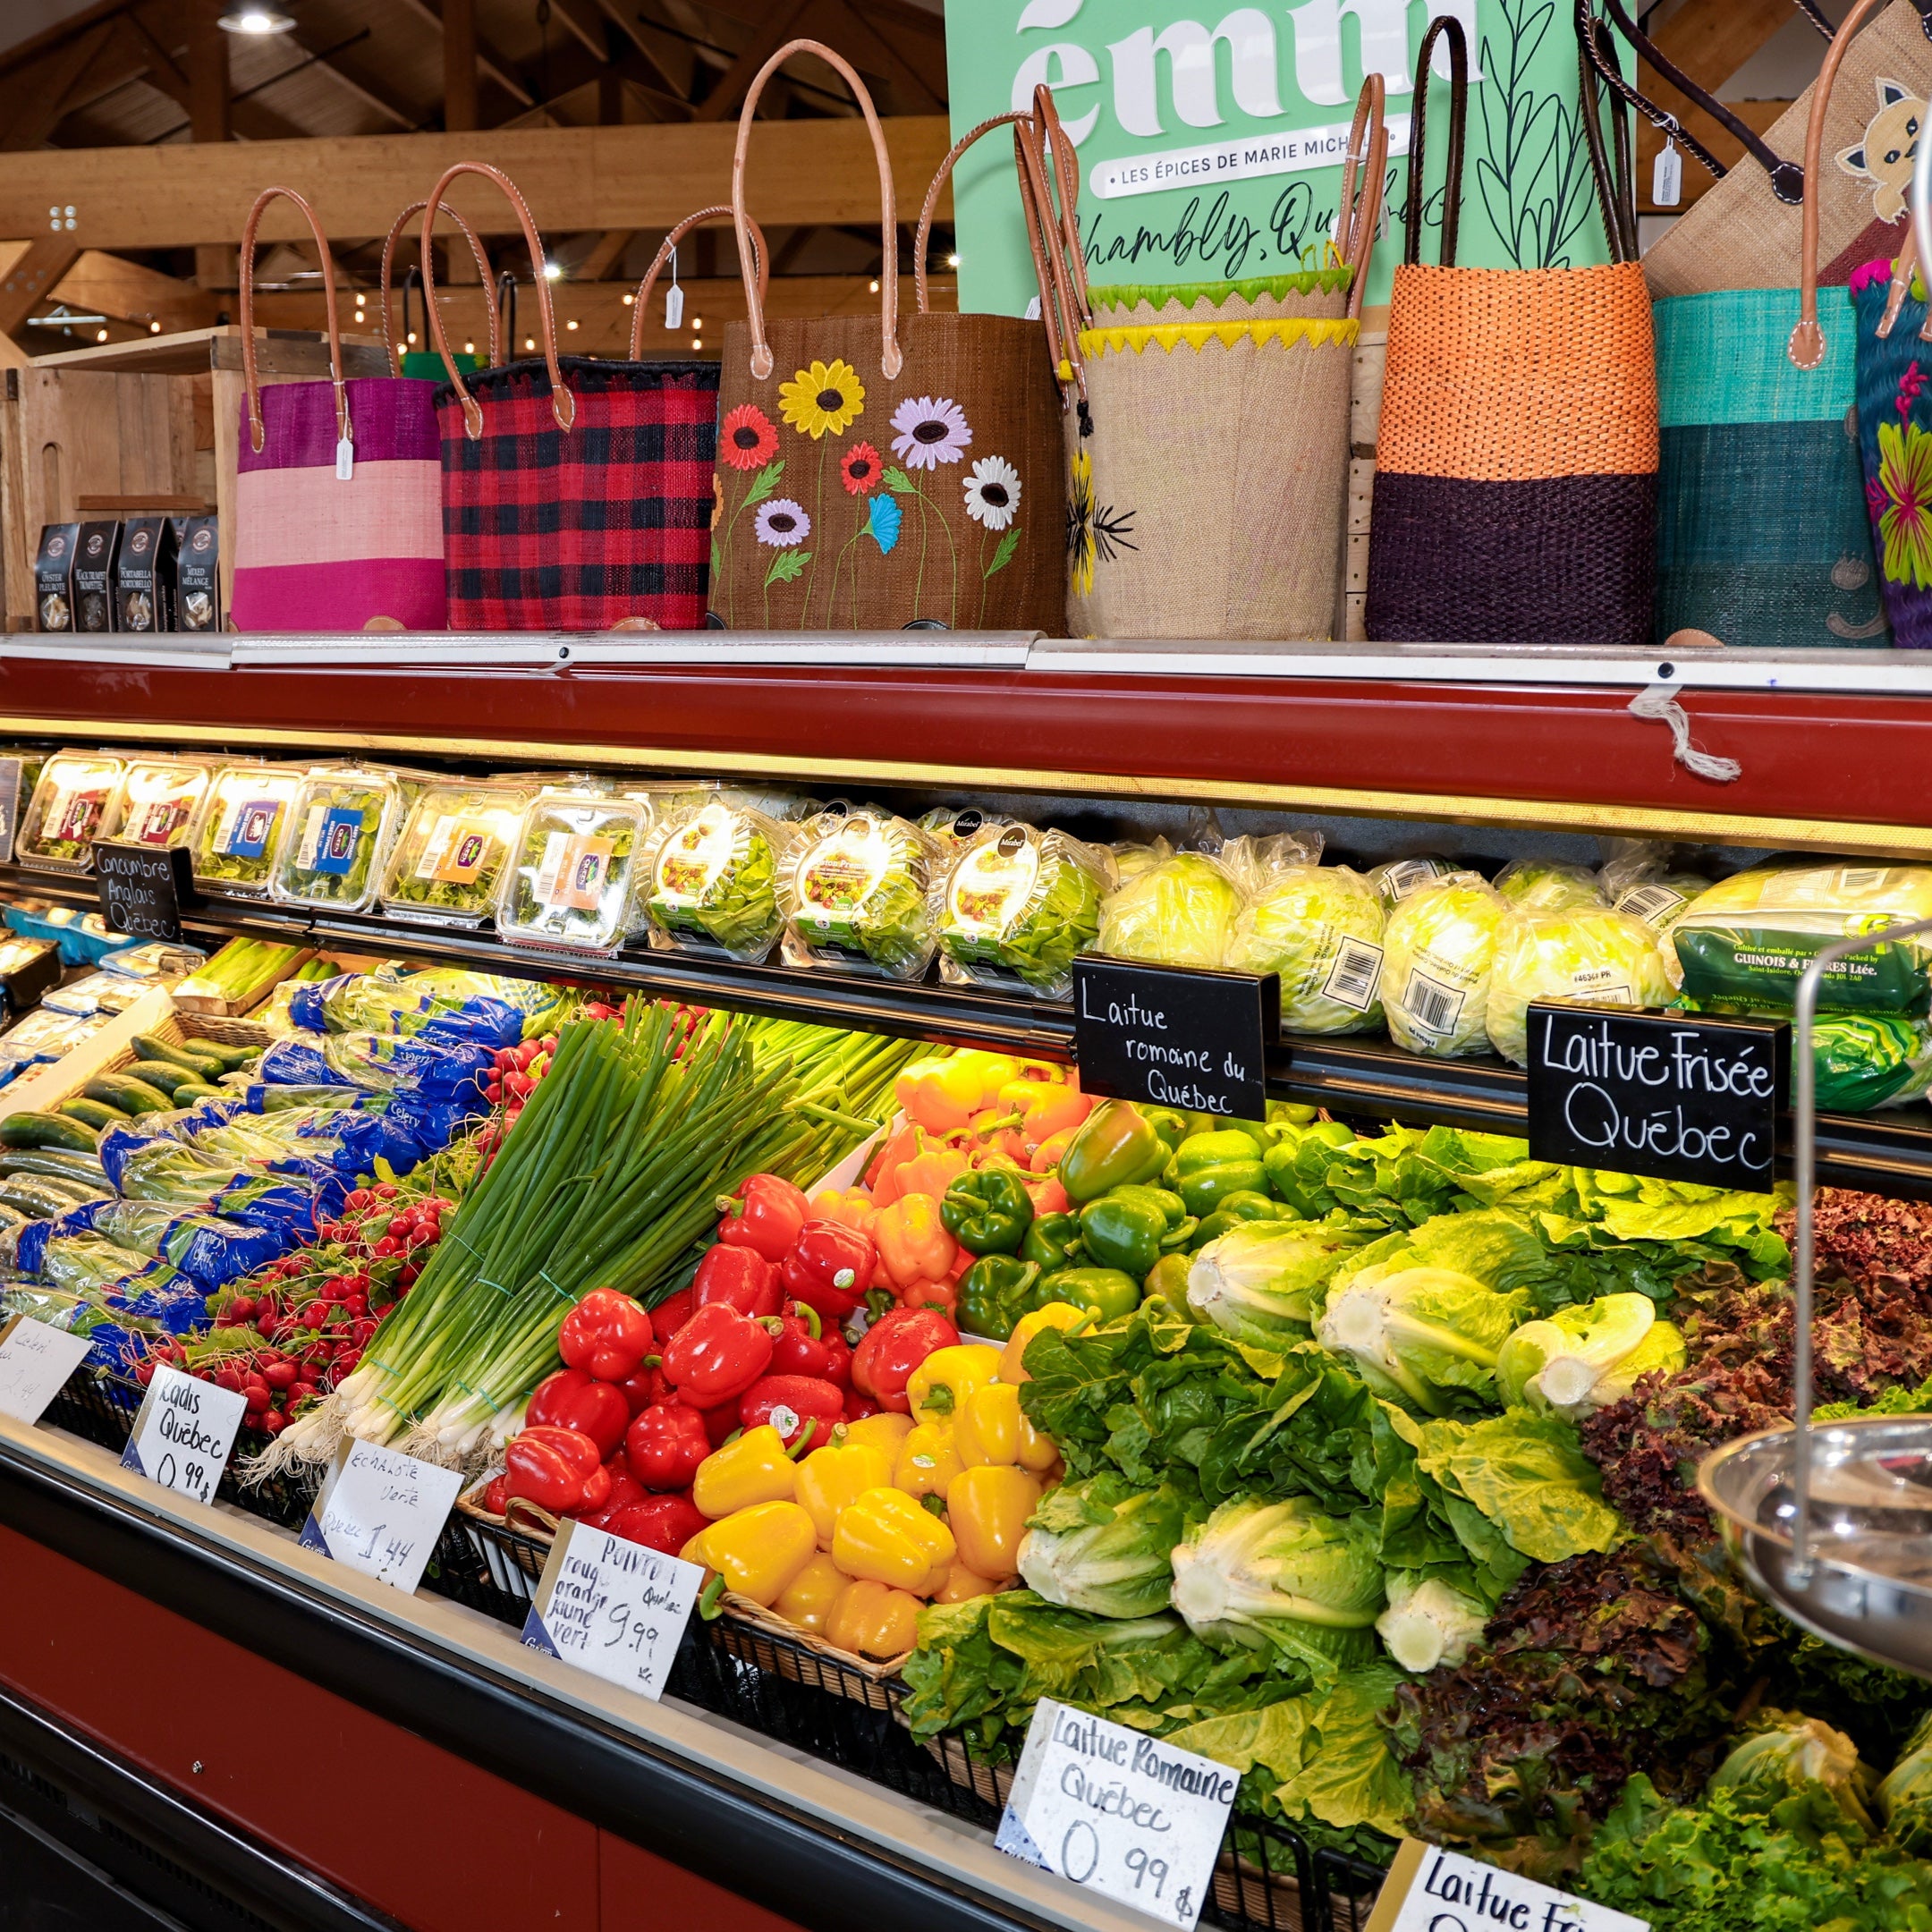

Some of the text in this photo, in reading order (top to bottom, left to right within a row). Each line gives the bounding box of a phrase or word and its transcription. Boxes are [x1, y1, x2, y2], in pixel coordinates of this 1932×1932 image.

[1122, 132, 1369, 184] LES ÉPICES DE MARIE MICHL
[1073, 168, 1465, 279] hambly, Qubc
[334, 828, 344, 852] QUEEN
[956, 820, 979, 828] Mirabel
[460, 838, 475, 863] QUEEN
[1001, 838, 1022, 847] Mirabel
[579, 858, 590, 886] QUEEN
[108, 878, 156, 909] Anglais
[110, 902, 175, 938] Québec
[1733, 944, 1758, 953] Cultivé
[1766, 946, 1794, 956] emballé
[1795, 950, 1807, 958] par
[1734, 953, 1877, 976] GUINOIS & FRES Ltée.
[1844, 953, 1868, 962] Packed
[1869, 954, 1879, 964] by
[1749, 965, 1792, 976] Saint-Isidore,
[1082, 977, 1168, 1029] Laitue
[1125, 1039, 1246, 1080] romaine du
[1543, 1014, 1775, 1098] Laitue Frisée
[1148, 1069, 1233, 1115] Québec
[391, 1103, 420, 1127] Celery
[1565, 1082, 1774, 1170] Québec
[90, 1343, 118, 1366] elery
[159, 1372, 200, 1414] Radis
[160, 1408, 223, 1460] Québec
[547, 1597, 593, 1629] jaune
[553, 1621, 589, 1650] vert
[1053, 1710, 1234, 1804] Laitue Romaine
[1061, 1763, 1171, 1832] Québec
[1424, 1855, 1530, 1930] Laitue
